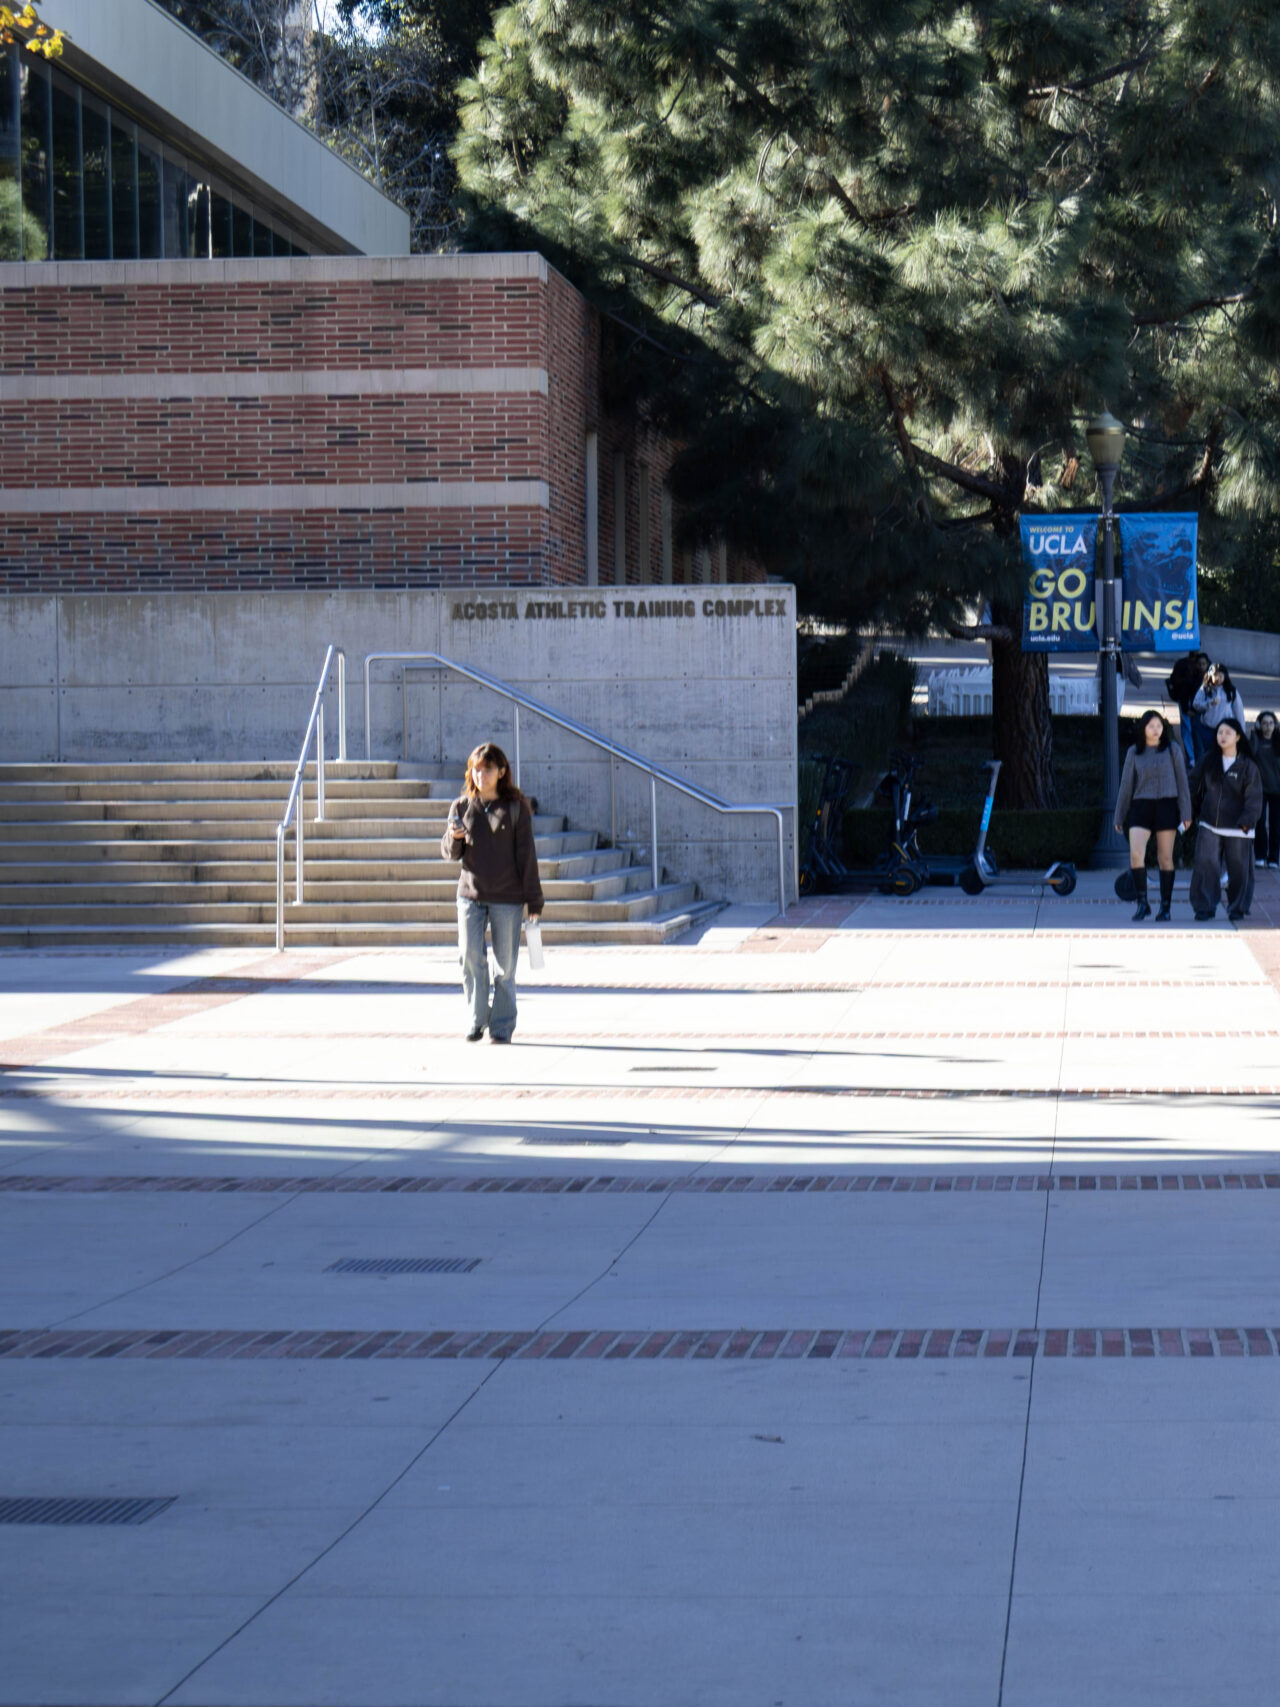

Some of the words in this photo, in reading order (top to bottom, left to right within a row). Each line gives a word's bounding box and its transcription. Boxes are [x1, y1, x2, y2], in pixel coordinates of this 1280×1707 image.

[1029, 526, 1063, 534] WELCOME
[1065, 525, 1074, 533] TO
[1029, 534, 1088, 555] UCLA
[1028, 568, 1087, 599] GO
[452, 600, 519, 620] ACOSTA
[524, 600, 607, 620] ATHLETIC
[613, 600, 696, 619] TRAINING
[702, 598, 787, 618] COMPLEX
[1028, 601, 1096, 631] BRU
[1122, 600, 1195, 631] INS!
[1030, 634, 1061, 643] ucla.edu
